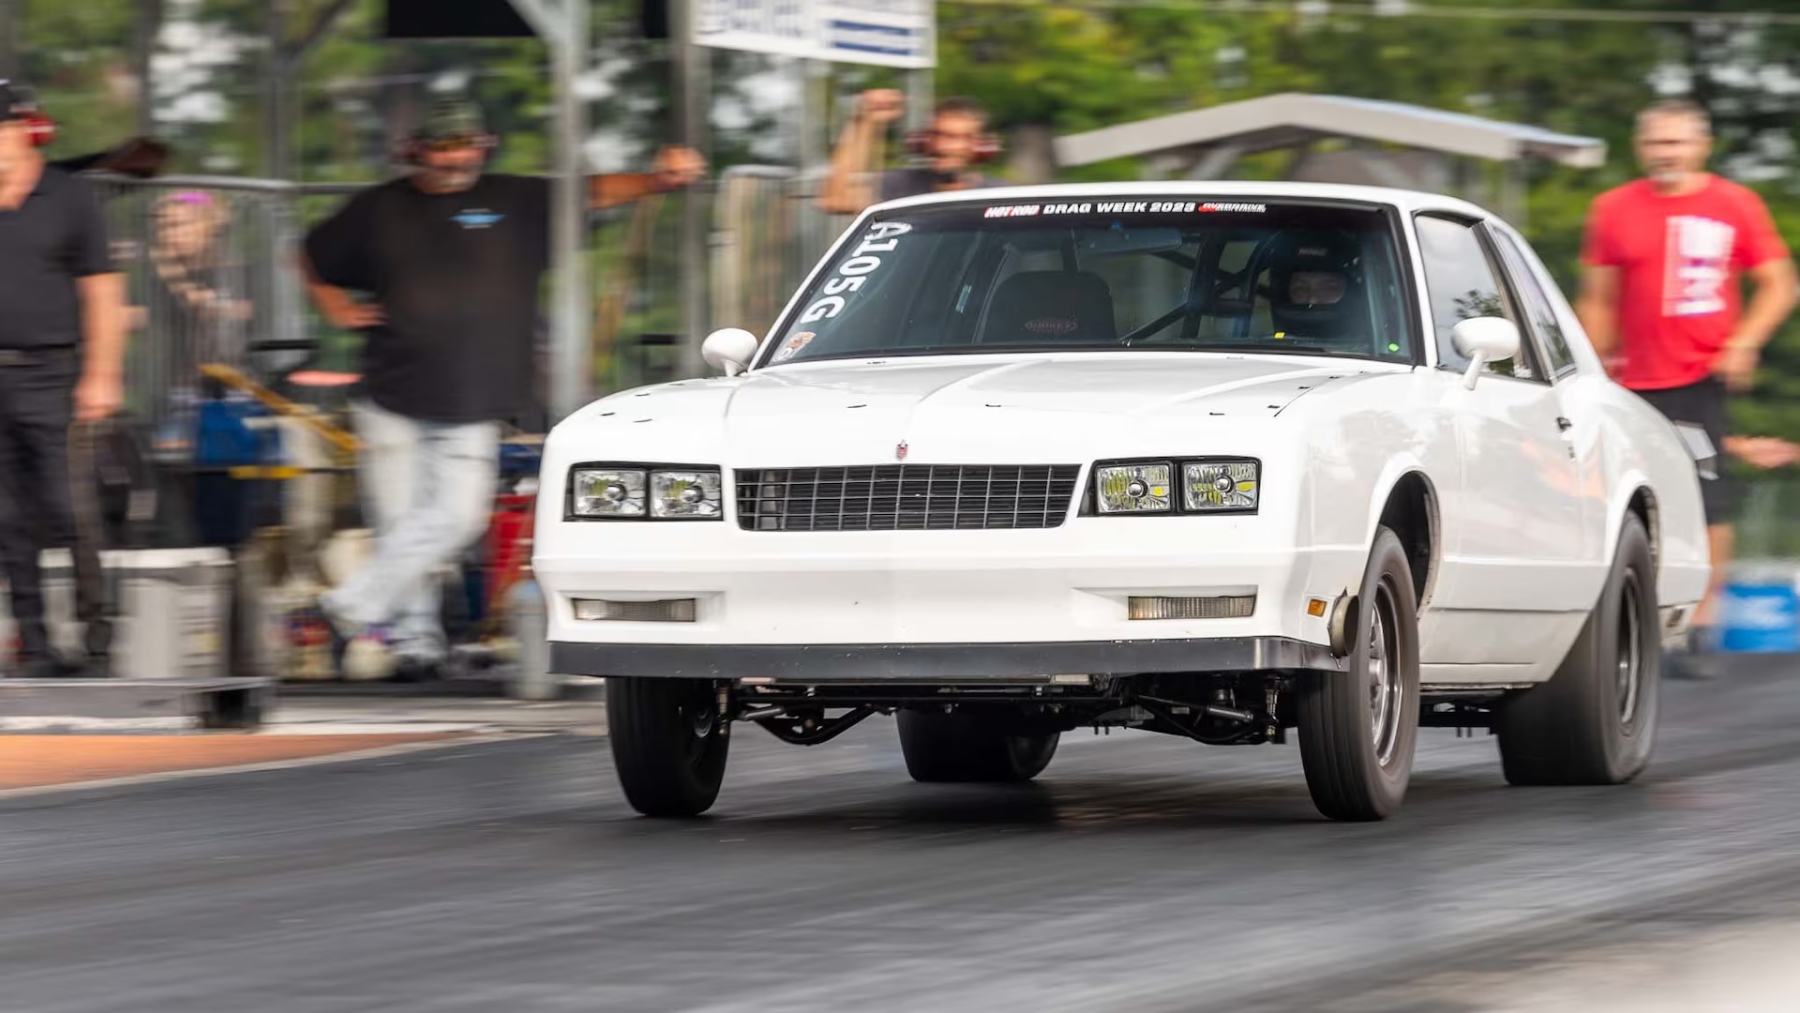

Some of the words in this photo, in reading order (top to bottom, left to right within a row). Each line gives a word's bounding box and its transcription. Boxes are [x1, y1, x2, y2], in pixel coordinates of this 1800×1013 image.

[1043, 203, 1092, 215] DRAG
[1097, 202, 1147, 213] WEEK
[1149, 202, 1196, 213] 2023
[800, 221, 912, 324] A105G
